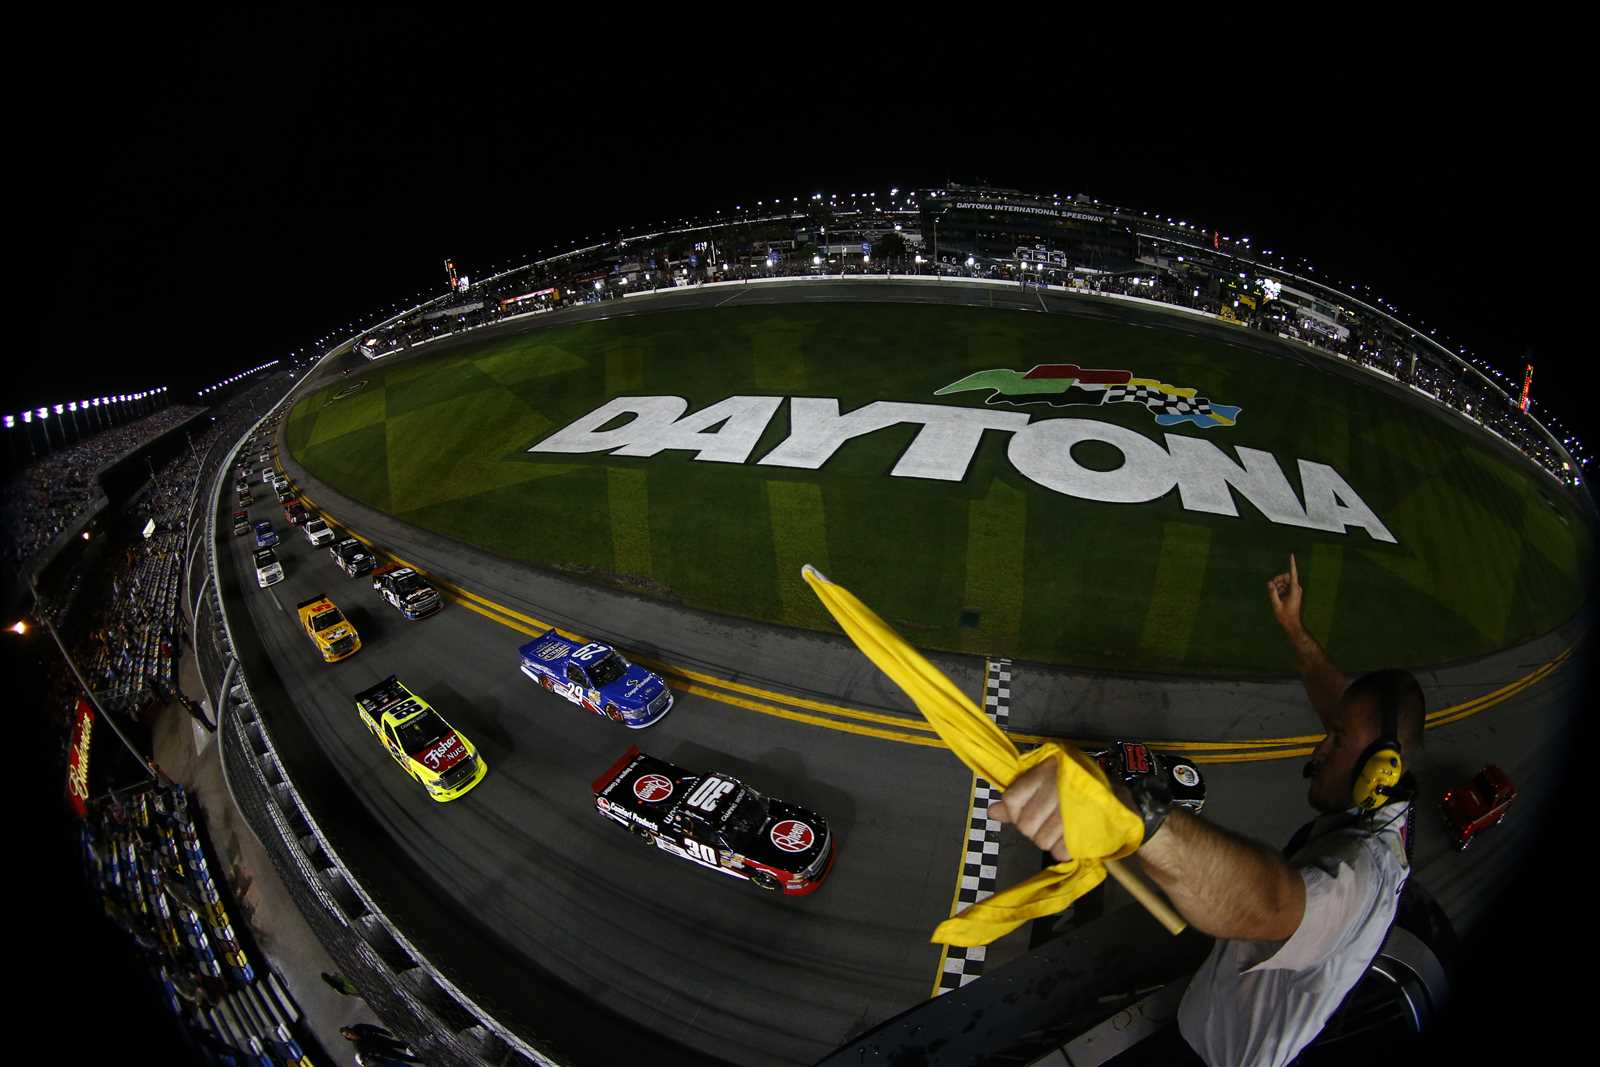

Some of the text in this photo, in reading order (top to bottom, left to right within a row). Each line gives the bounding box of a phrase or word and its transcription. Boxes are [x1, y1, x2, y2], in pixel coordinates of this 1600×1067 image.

[956, 202, 1104, 223] DAYTONA INTERNATIONAL SPEEDWAY
[527, 395, 1399, 544] DAYTONA
[567, 682, 583, 701] 29
[424, 734, 457, 769] Fisher
[447, 745, 466, 761] Nuts
[686, 776, 736, 813] 30
[684, 837, 718, 866] 30
